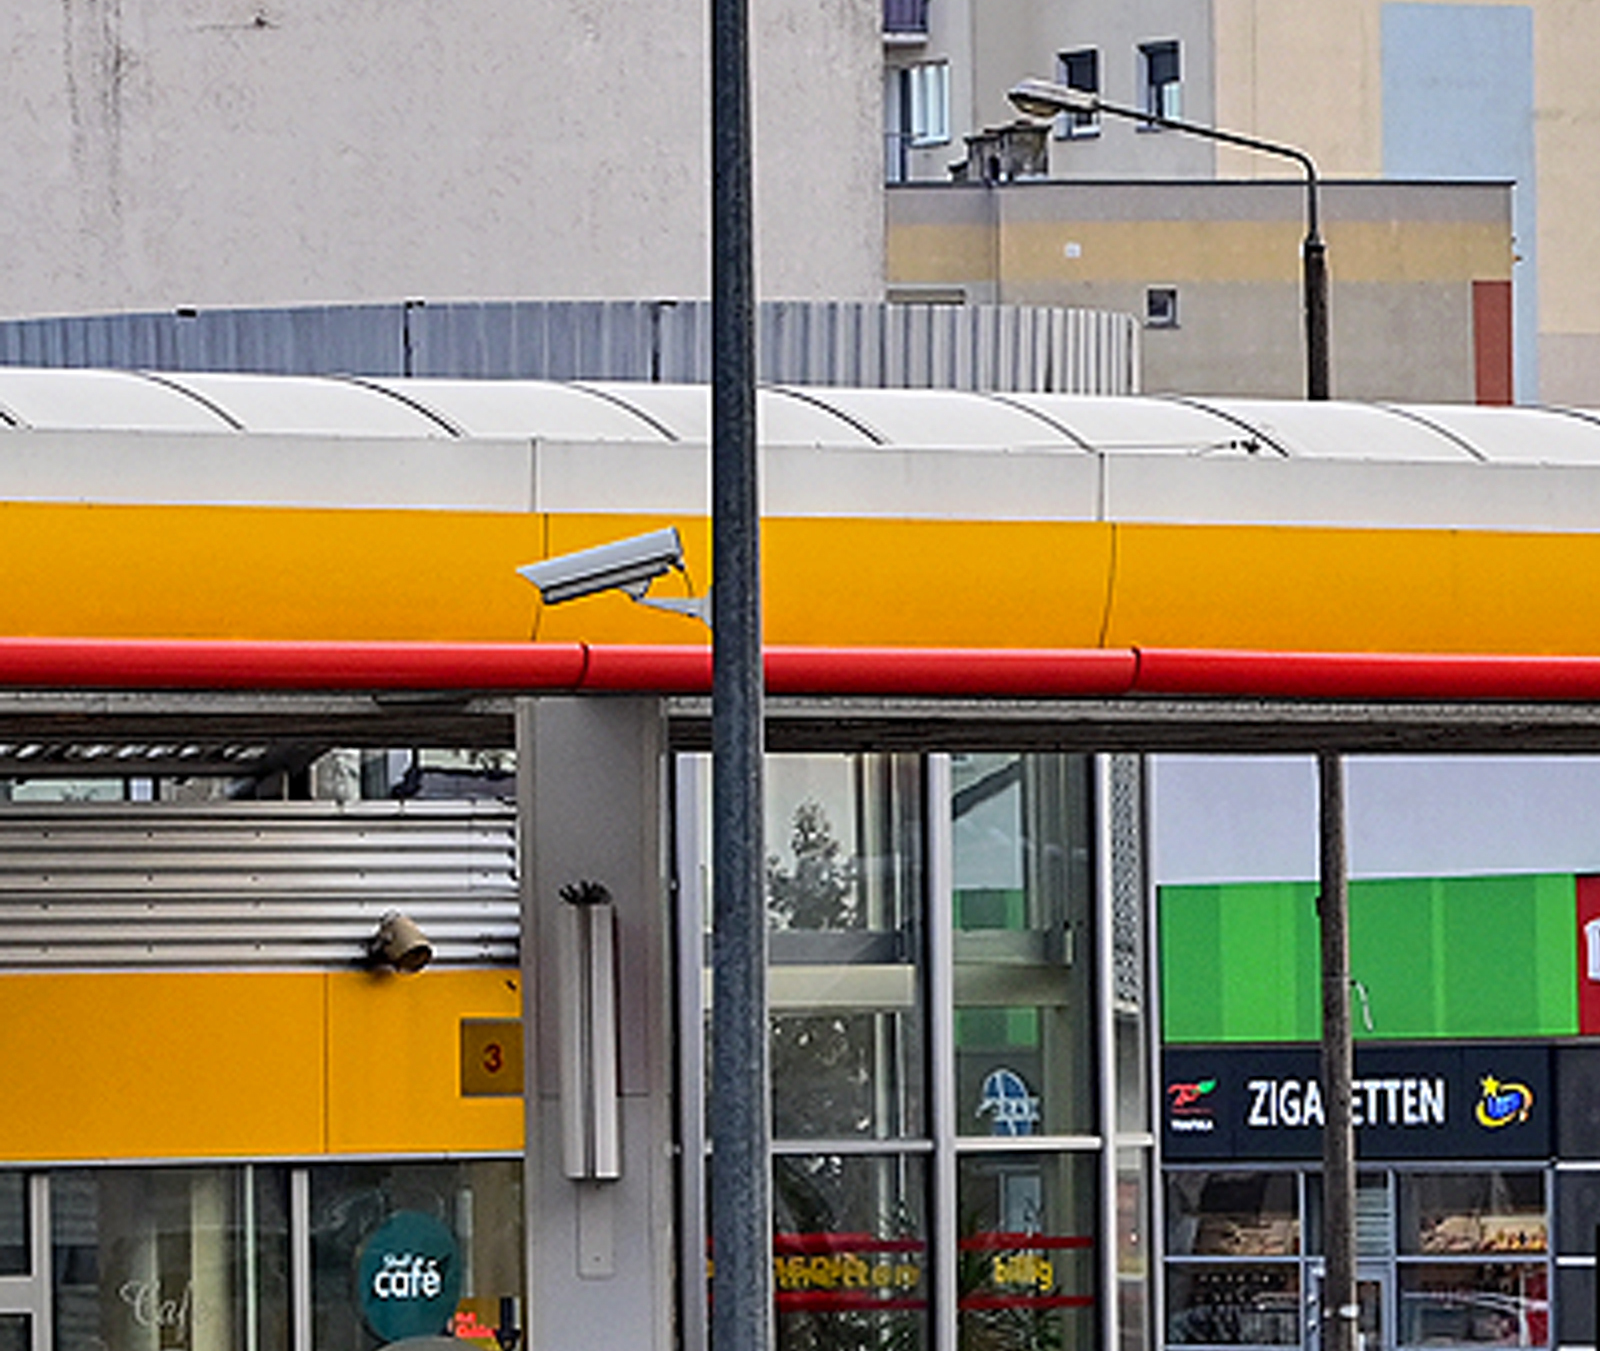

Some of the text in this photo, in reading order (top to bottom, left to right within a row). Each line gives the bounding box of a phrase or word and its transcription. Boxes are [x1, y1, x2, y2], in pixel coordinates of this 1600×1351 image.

[483, 1043, 503, 1073] 3
[1247, 1078, 1445, 1127] ZIGAETTEN
[374, 1260, 442, 1299] café
